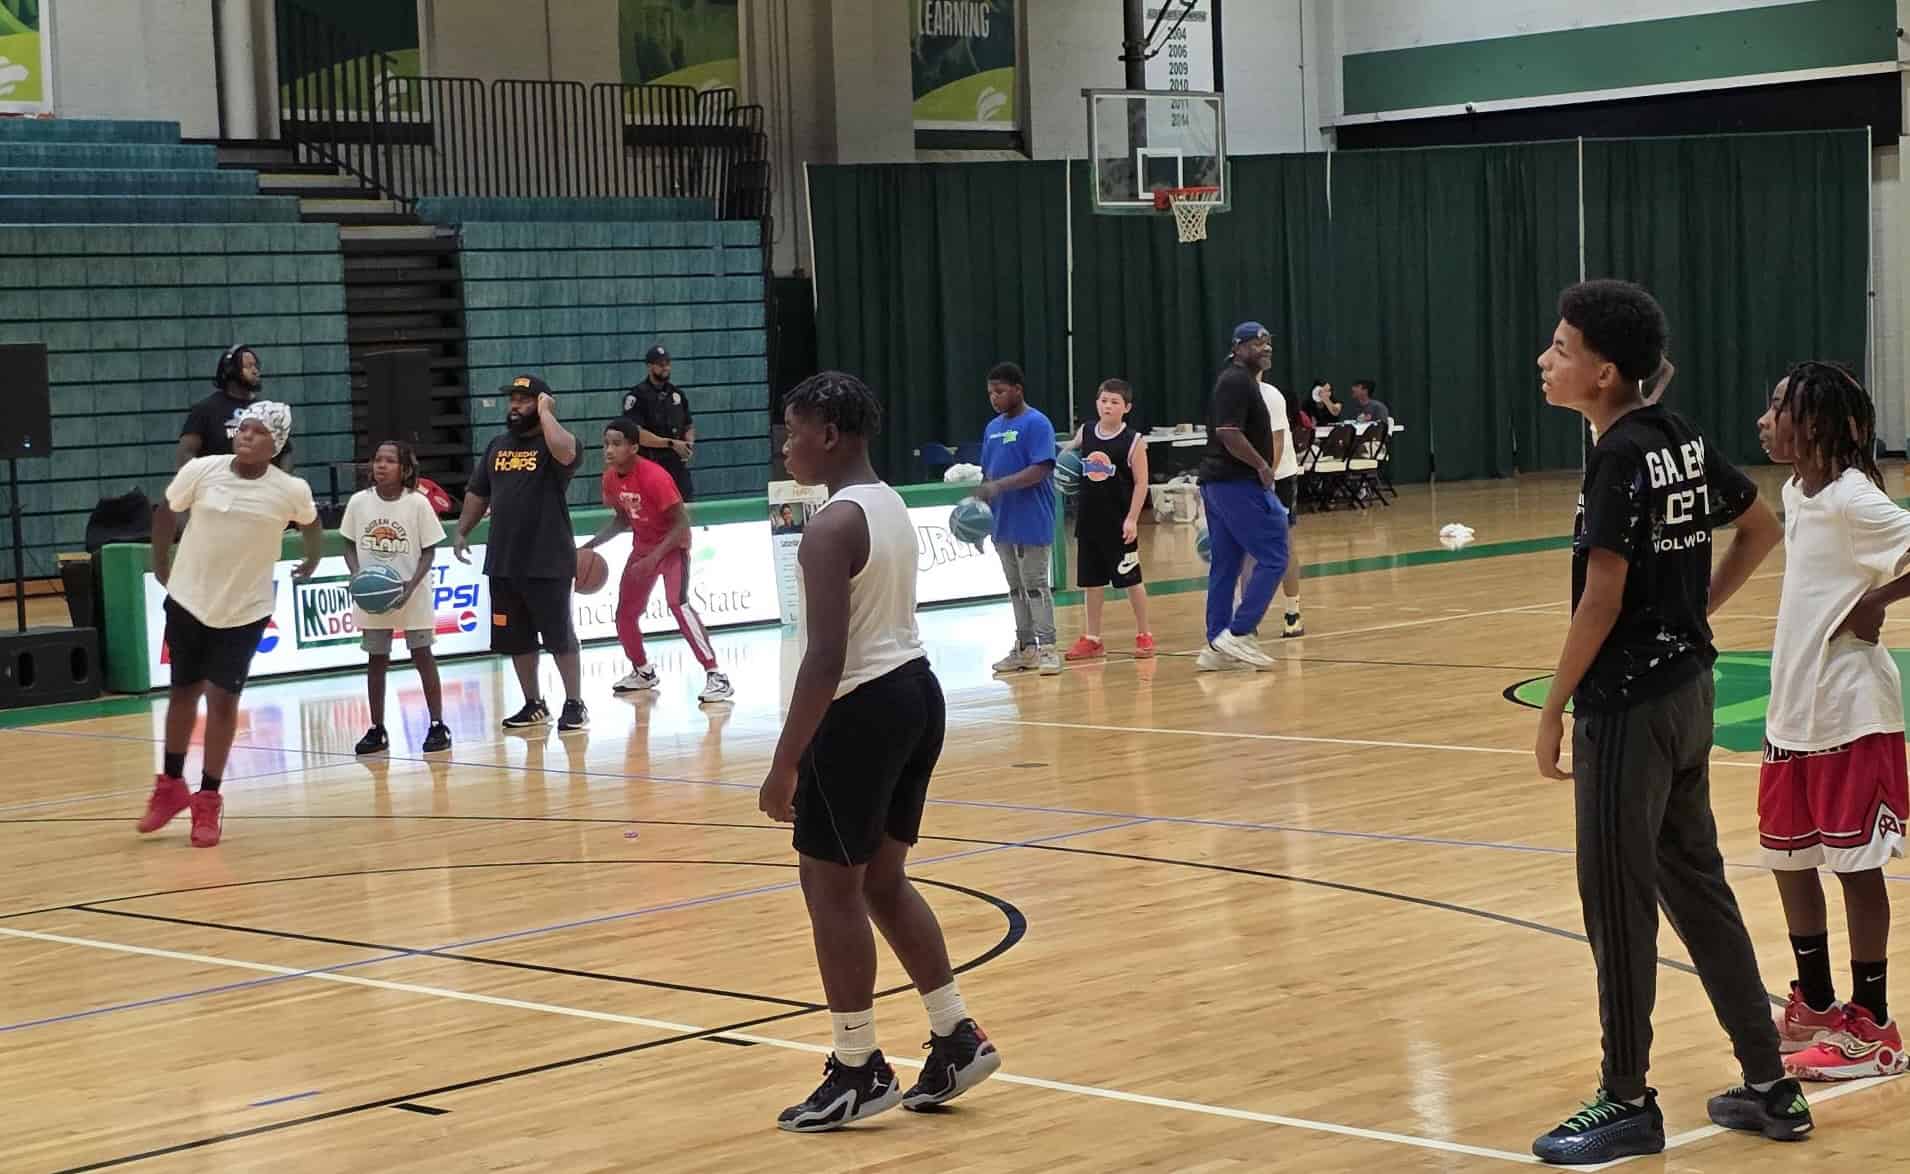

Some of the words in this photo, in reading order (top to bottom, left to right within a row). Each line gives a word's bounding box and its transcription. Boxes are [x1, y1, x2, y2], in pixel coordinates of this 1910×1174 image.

[919, 0, 990, 38] LEARNING
[1168, 44, 1188, 58] 2006
[1168, 61, 1189, 75] 2009
[1169, 79, 1189, 92] 2010
[361, 534, 410, 553] SLAM
[432, 584, 480, 610] PSI
[302, 586, 353, 637] MOUNT
